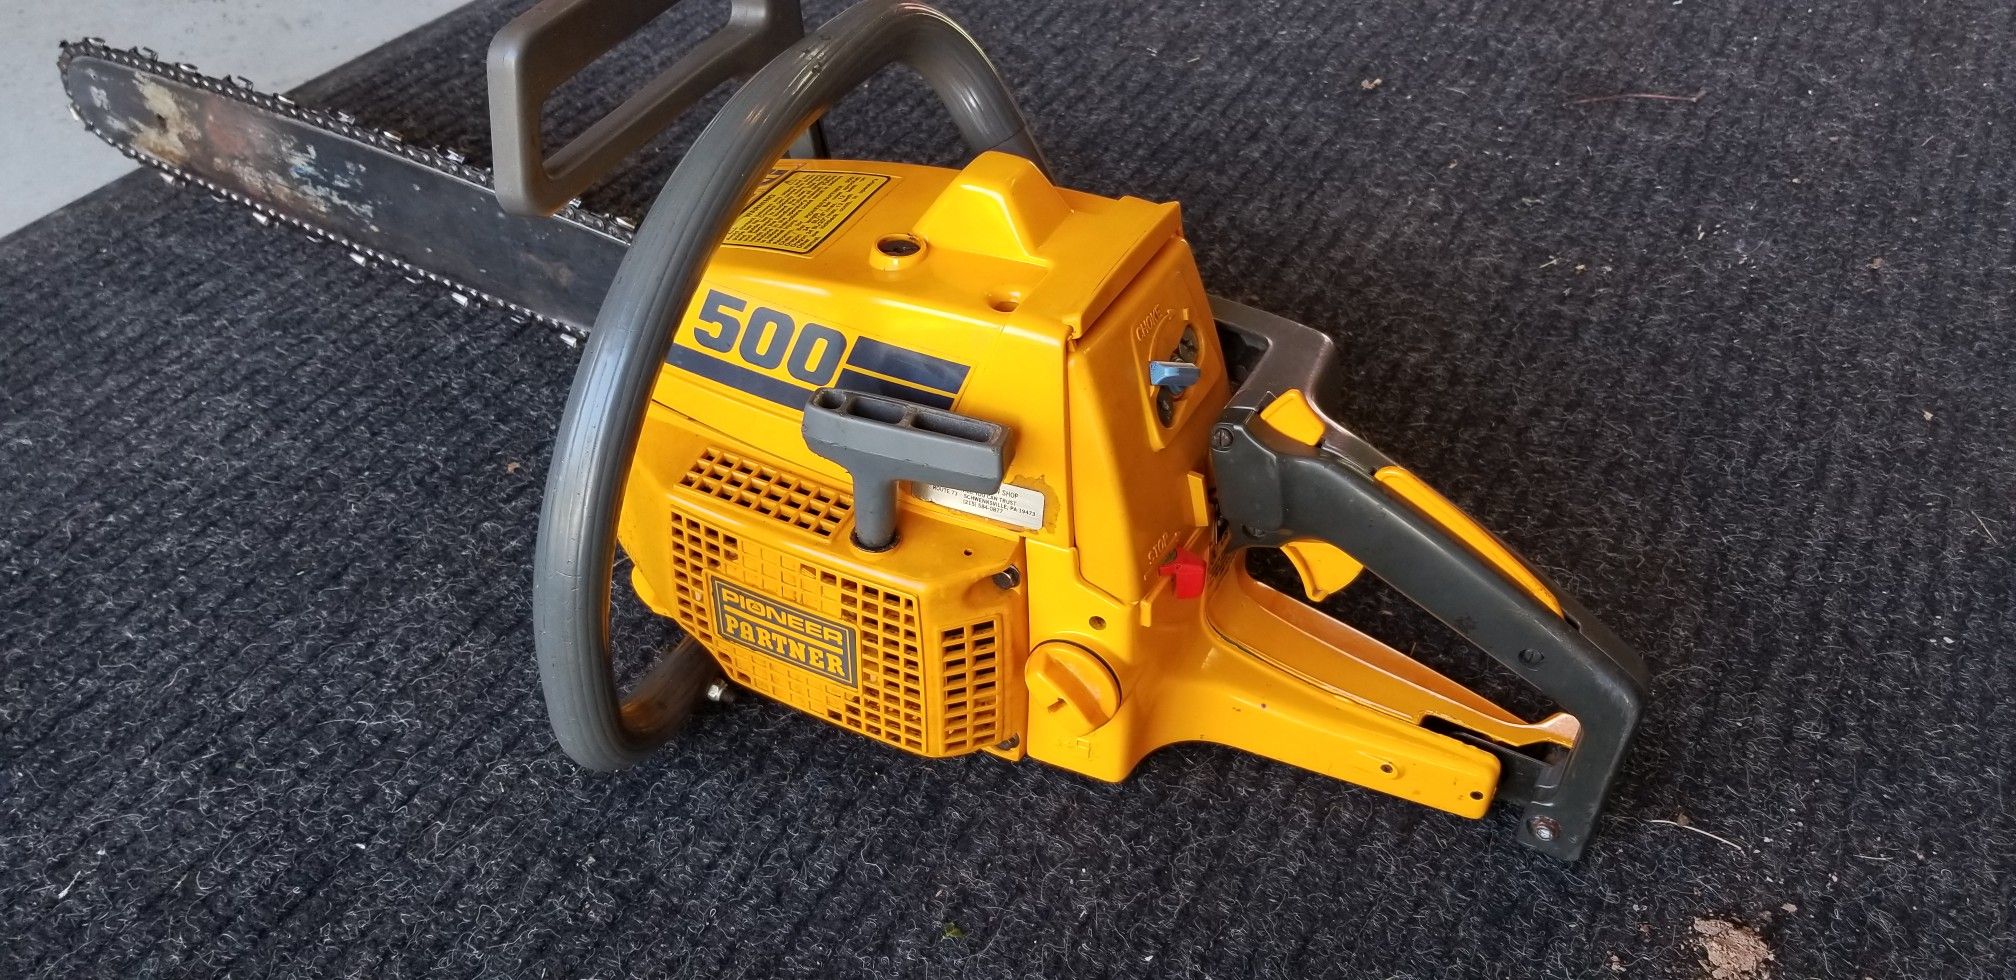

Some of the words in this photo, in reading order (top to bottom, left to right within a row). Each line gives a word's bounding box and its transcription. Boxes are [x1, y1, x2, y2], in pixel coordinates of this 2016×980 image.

[693, 288, 848, 387] 500
[1135, 303, 1160, 342] CHOKE
[999, 497, 1017, 506] TRUST
[1002, 489, 1019, 499] SHOP
[1019, 507, 1036, 517] 19473
[1147, 532, 1169, 566] STOP
[721, 587, 843, 646] PIONEER
[724, 612, 846, 677] PARTNER
